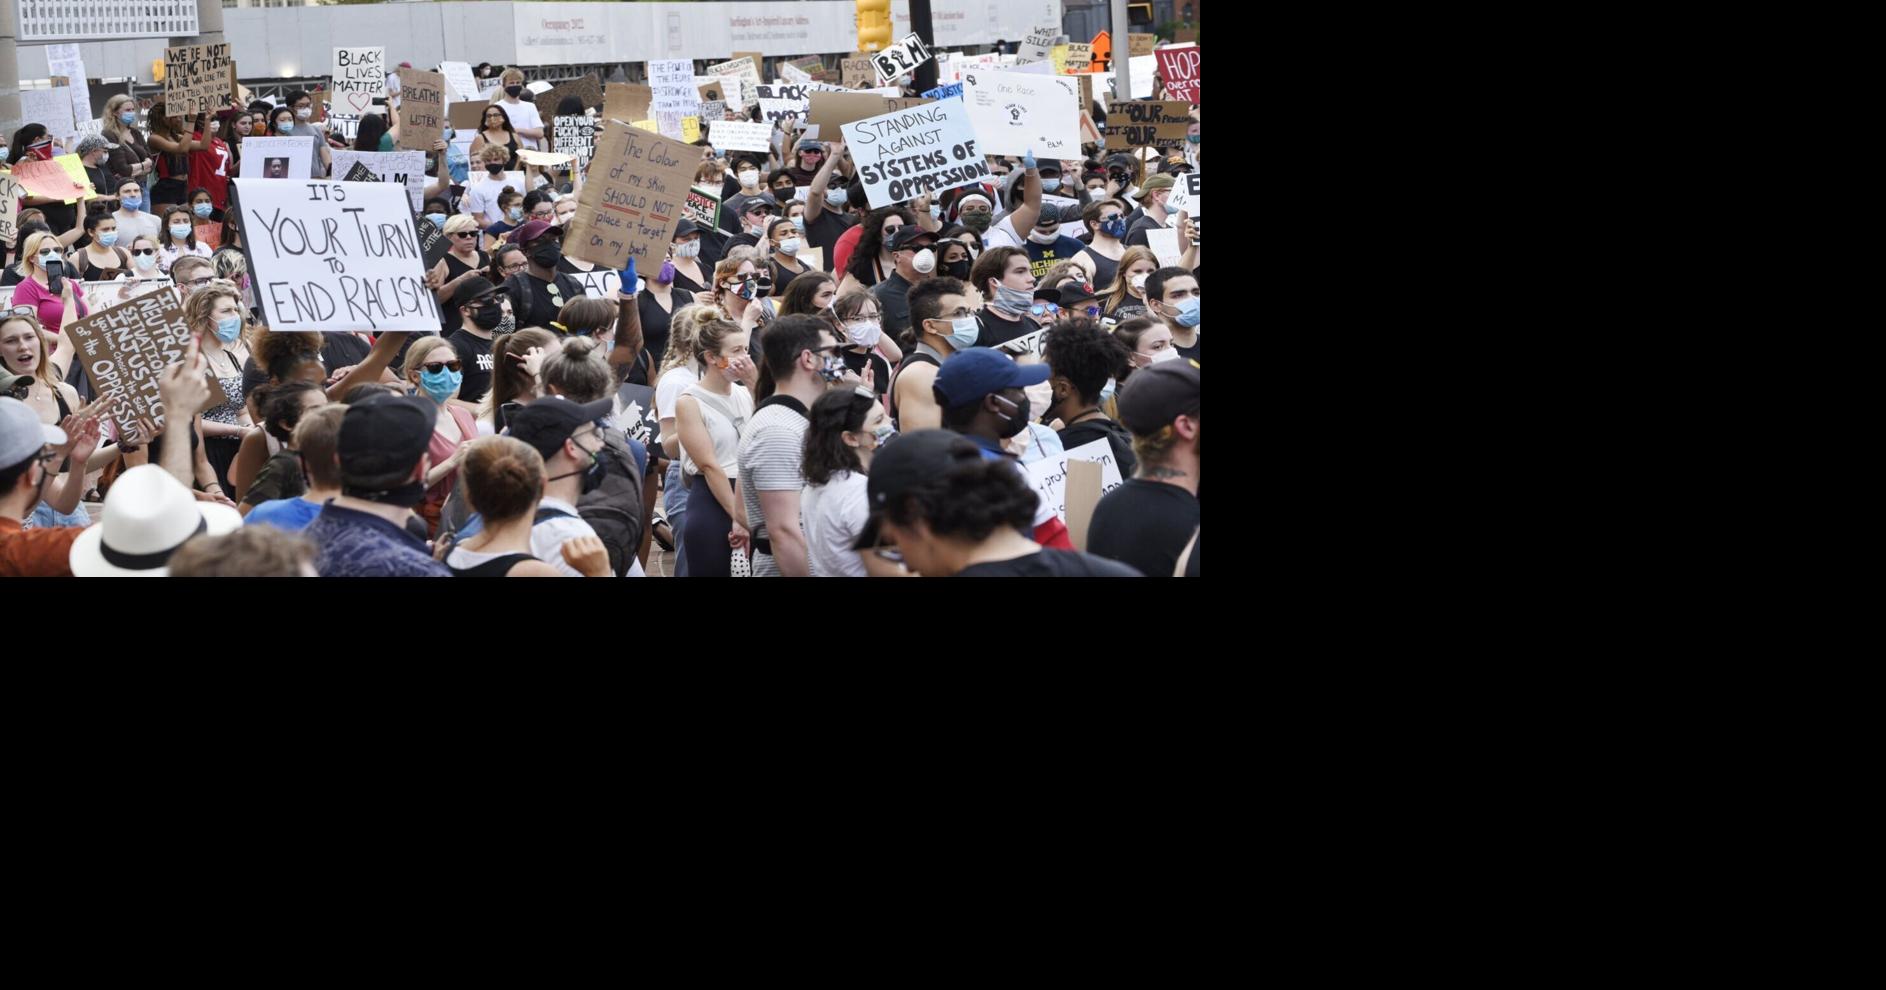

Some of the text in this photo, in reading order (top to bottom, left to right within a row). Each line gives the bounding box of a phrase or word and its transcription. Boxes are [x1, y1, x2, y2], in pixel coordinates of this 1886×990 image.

[207, 44, 226, 57] NOT
[338, 50, 381, 66] BLACK
[878, 40, 926, 77] BLM
[166, 56, 231, 78] TRYING TO START
[346, 65, 381, 79] LIVES
[651, 63, 666, 74] THE
[1163, 51, 1200, 79] HOP
[168, 79, 174, 91] A
[217, 71, 226, 79] THE
[333, 80, 383, 93] MATTER
[941, 82, 963, 98] JUSTIC
[217, 93, 232, 107] ONE
[402, 85, 440, 104] BREATHE
[756, 84, 809, 101] BLACK
[410, 113, 438, 128] LISTEN
[554, 115, 593, 127] OPEN YOUR
[1130, 104, 1163, 122] OUR
[855, 107, 947, 145] STANDING
[1126, 125, 1157, 145] OUR
[554, 136, 593, 147] DIFFERENT
[623, 131, 680, 167] The Colour
[878, 128, 942, 160] AGAINST
[215, 150, 228, 177] 7
[861, 140, 976, 185] SYSTEMS OF
[609, 164, 628, 180] of
[629, 175, 642, 187] my
[888, 160, 989, 201] OPPRESSION
[602, 187, 675, 216] SHOULD NOT
[688, 200, 707, 214] EACE
[252, 207, 418, 260] YOUR TURN
[595, 212, 667, 240] place a target
[610, 239, 624, 250] my
[323, 257, 345, 274] TO
[269, 275, 436, 329] END RACISM
[157, 291, 192, 346] IF YOU
[75, 326, 91, 338] of
[83, 338, 100, 357] the
[122, 305, 164, 379] SITUATION
[105, 309, 165, 427] INJUSTICE
